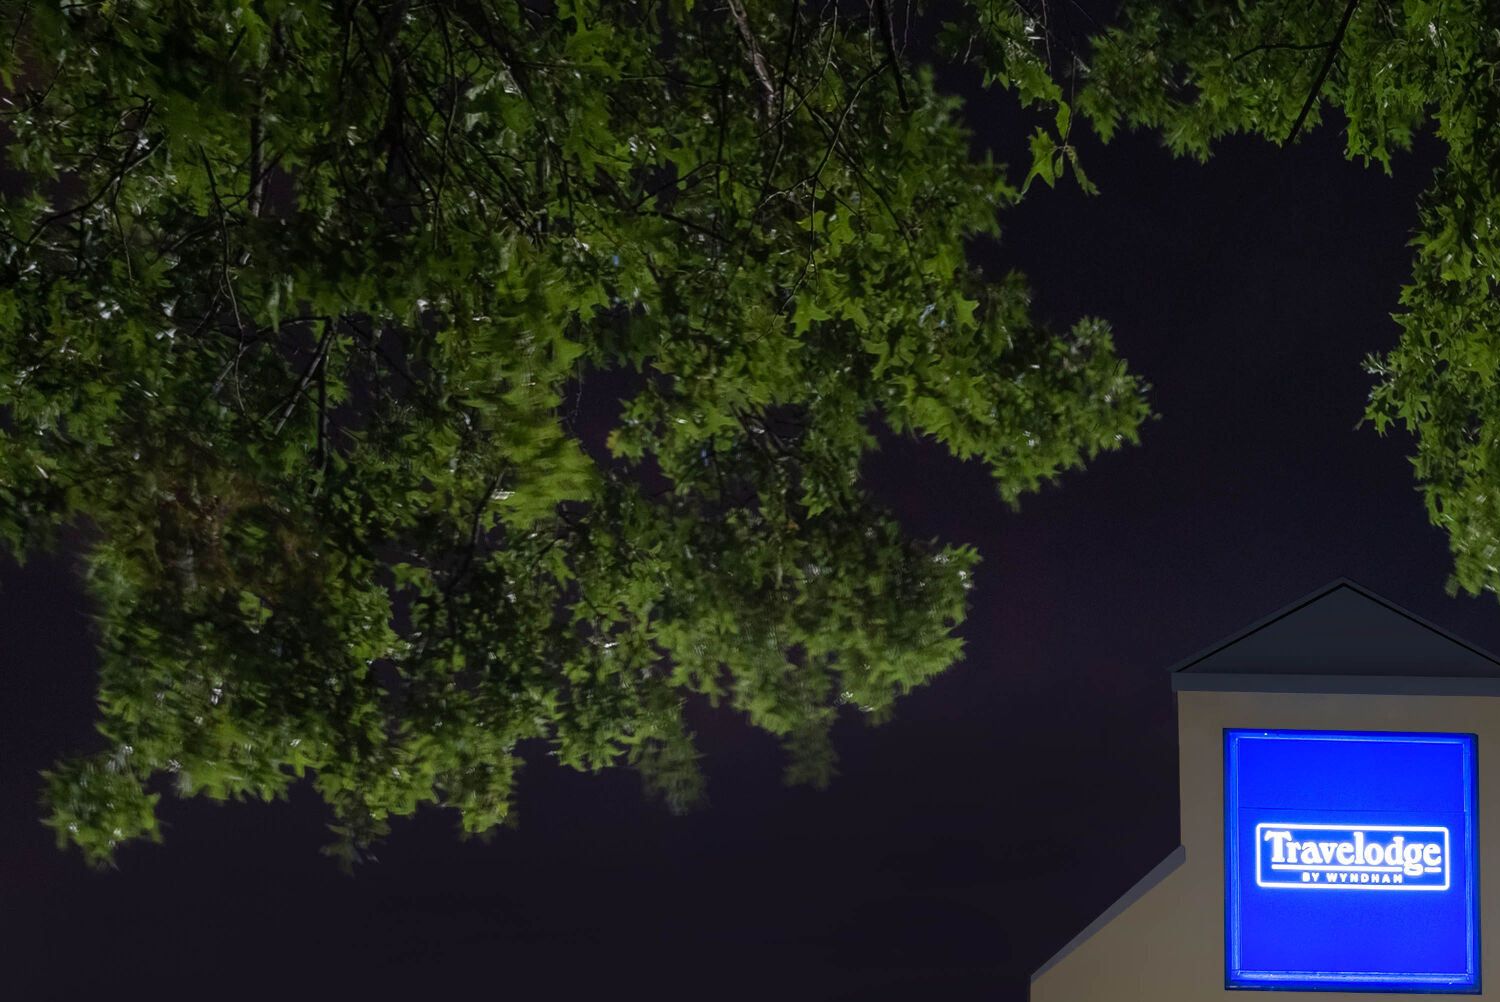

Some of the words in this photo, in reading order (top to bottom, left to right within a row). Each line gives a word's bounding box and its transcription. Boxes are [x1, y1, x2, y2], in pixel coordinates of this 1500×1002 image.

[1264, 830, 1442, 876] Travelodge
[1302, 872, 1320, 882] BY
[1326, 872, 1403, 884] WYNDHAM
